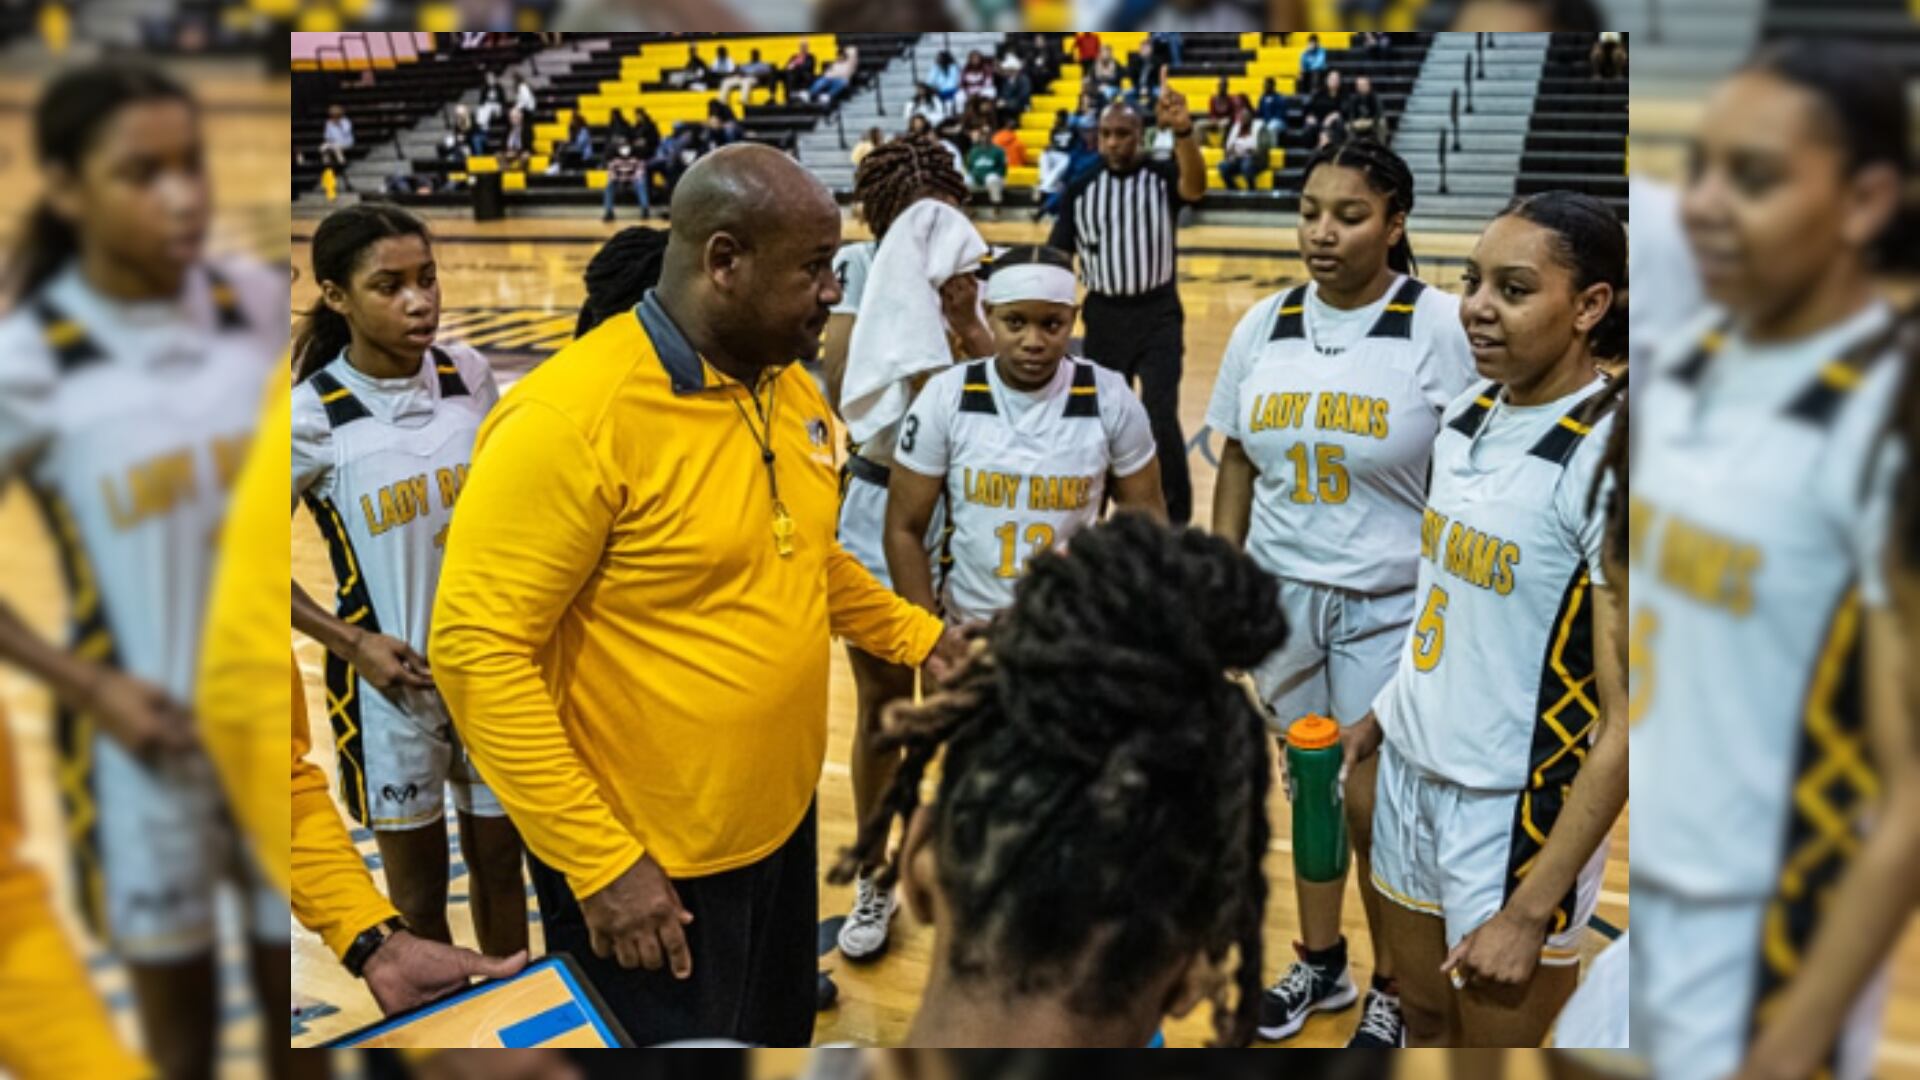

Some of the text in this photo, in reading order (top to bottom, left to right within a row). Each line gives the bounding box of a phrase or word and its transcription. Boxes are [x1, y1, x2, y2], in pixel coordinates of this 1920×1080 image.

[1249, 391, 1389, 440] LADY RAMS
[963, 465, 1093, 512] LADY RAMS
[1284, 441, 1350, 505] 15
[360, 473, 430, 538] LADY
[1443, 519, 1520, 597] RAMS
[1411, 583, 1449, 673] 5
